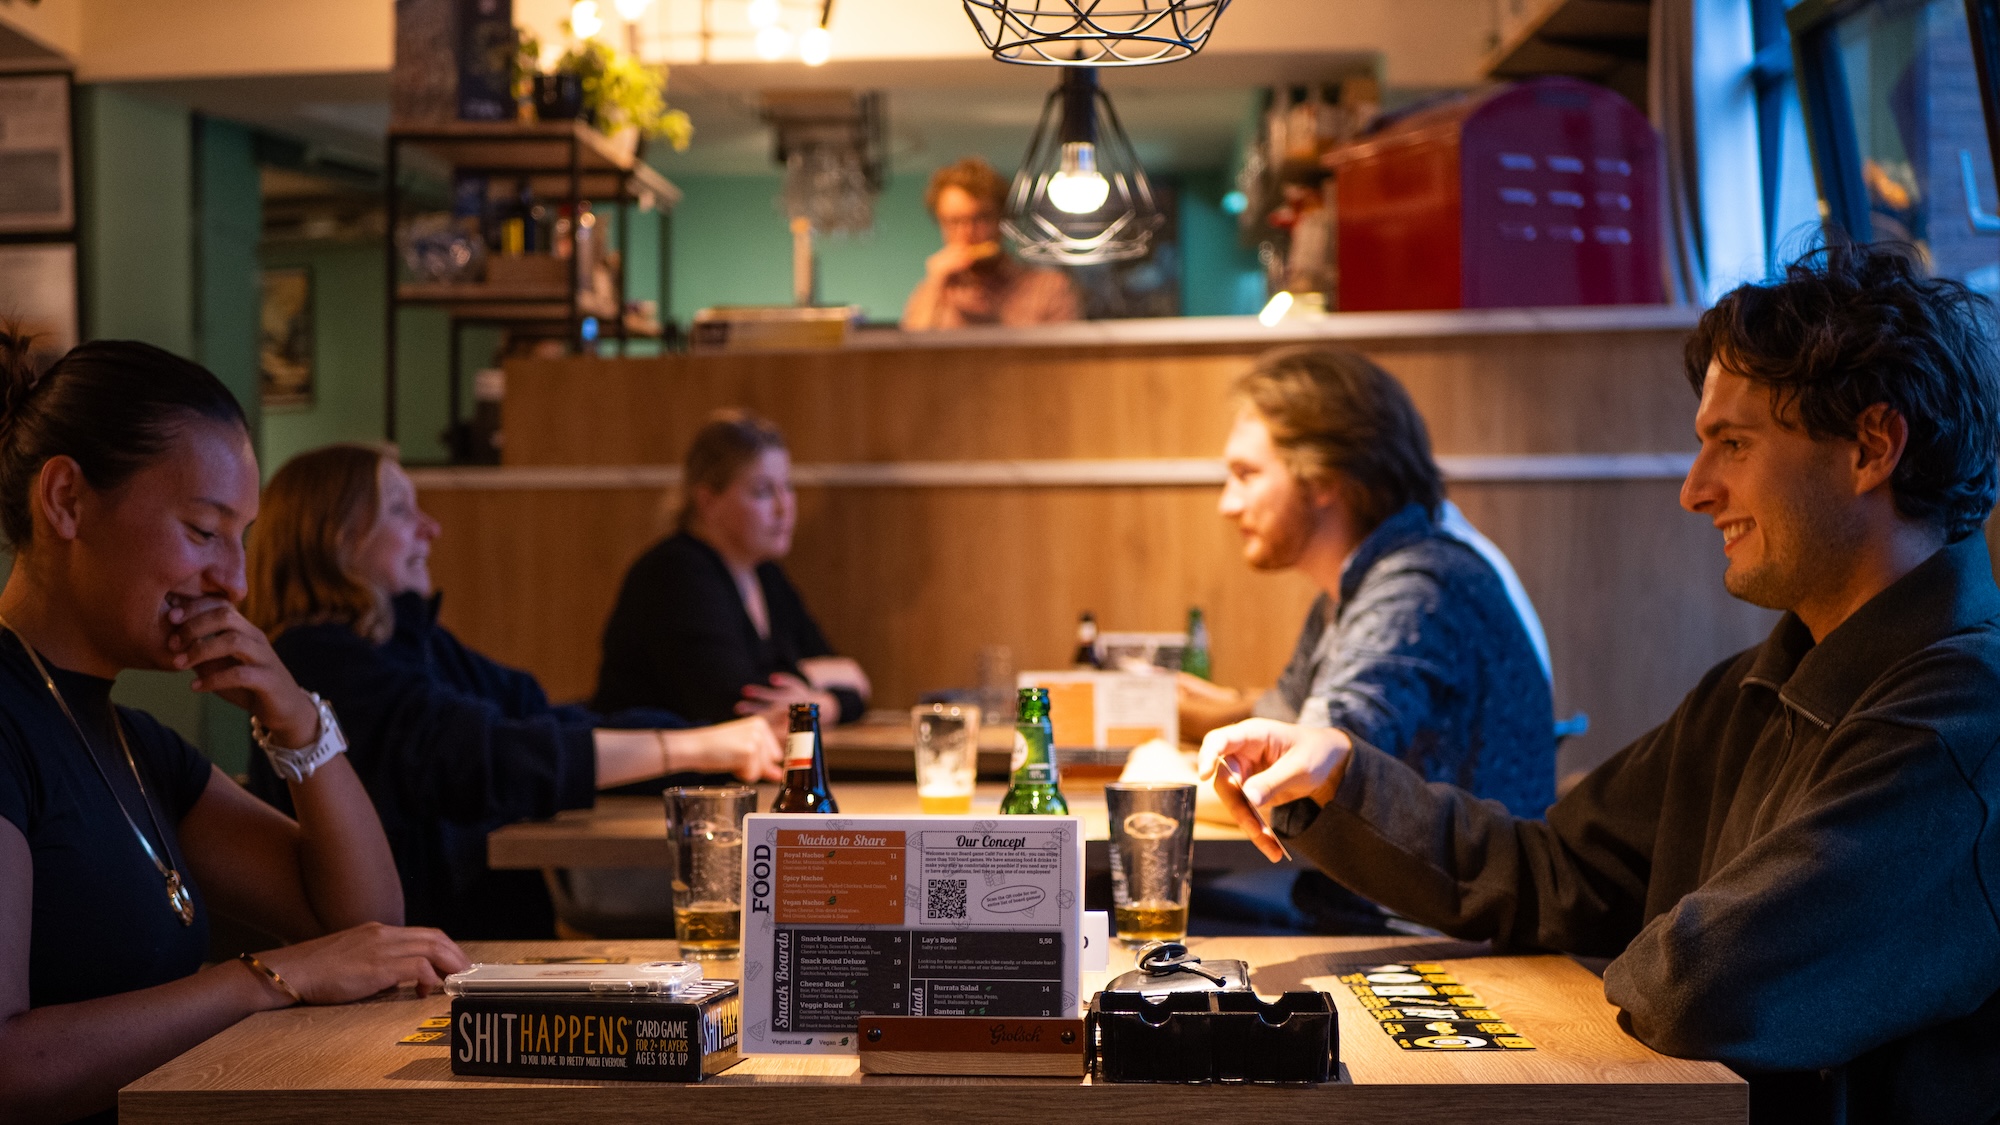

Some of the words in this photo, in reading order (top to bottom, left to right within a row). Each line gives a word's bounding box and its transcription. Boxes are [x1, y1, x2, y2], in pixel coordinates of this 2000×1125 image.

[798, 834, 838, 846] Nachos
[840, 834, 850, 846] to
[854, 834, 886, 846] Share
[956, 835, 980, 847] Our
[982, 835, 1026, 850] Concept
[752, 844, 770, 913] FOOD
[774, 932, 789, 982] Boards
[774, 985, 789, 1028] Snack
[459, 1012, 517, 1064] SHIT
[636, 1020, 660, 1038] CARD
[661, 1021, 688, 1038] GAME
[703, 1008, 721, 1056] SHIT
[990, 1024, 1042, 1045] Grolsch
[636, 1039, 648, 1052] FOR
[650, 1039, 658, 1052] 2+
[660, 1039, 688, 1052] PLAYERS
[521, 1055, 527, 1064] TO
[541, 1056, 547, 1065] TO
[559, 1056, 565, 1065] TO
[566, 1056, 584, 1066] PRETTY
[586, 1057, 601, 1067] MUCH
[636, 1052, 655, 1065] AGES
[658, 1052, 667, 1065] 18
[668, 1052, 675, 1065] &
[678, 1052, 688, 1066] UP
